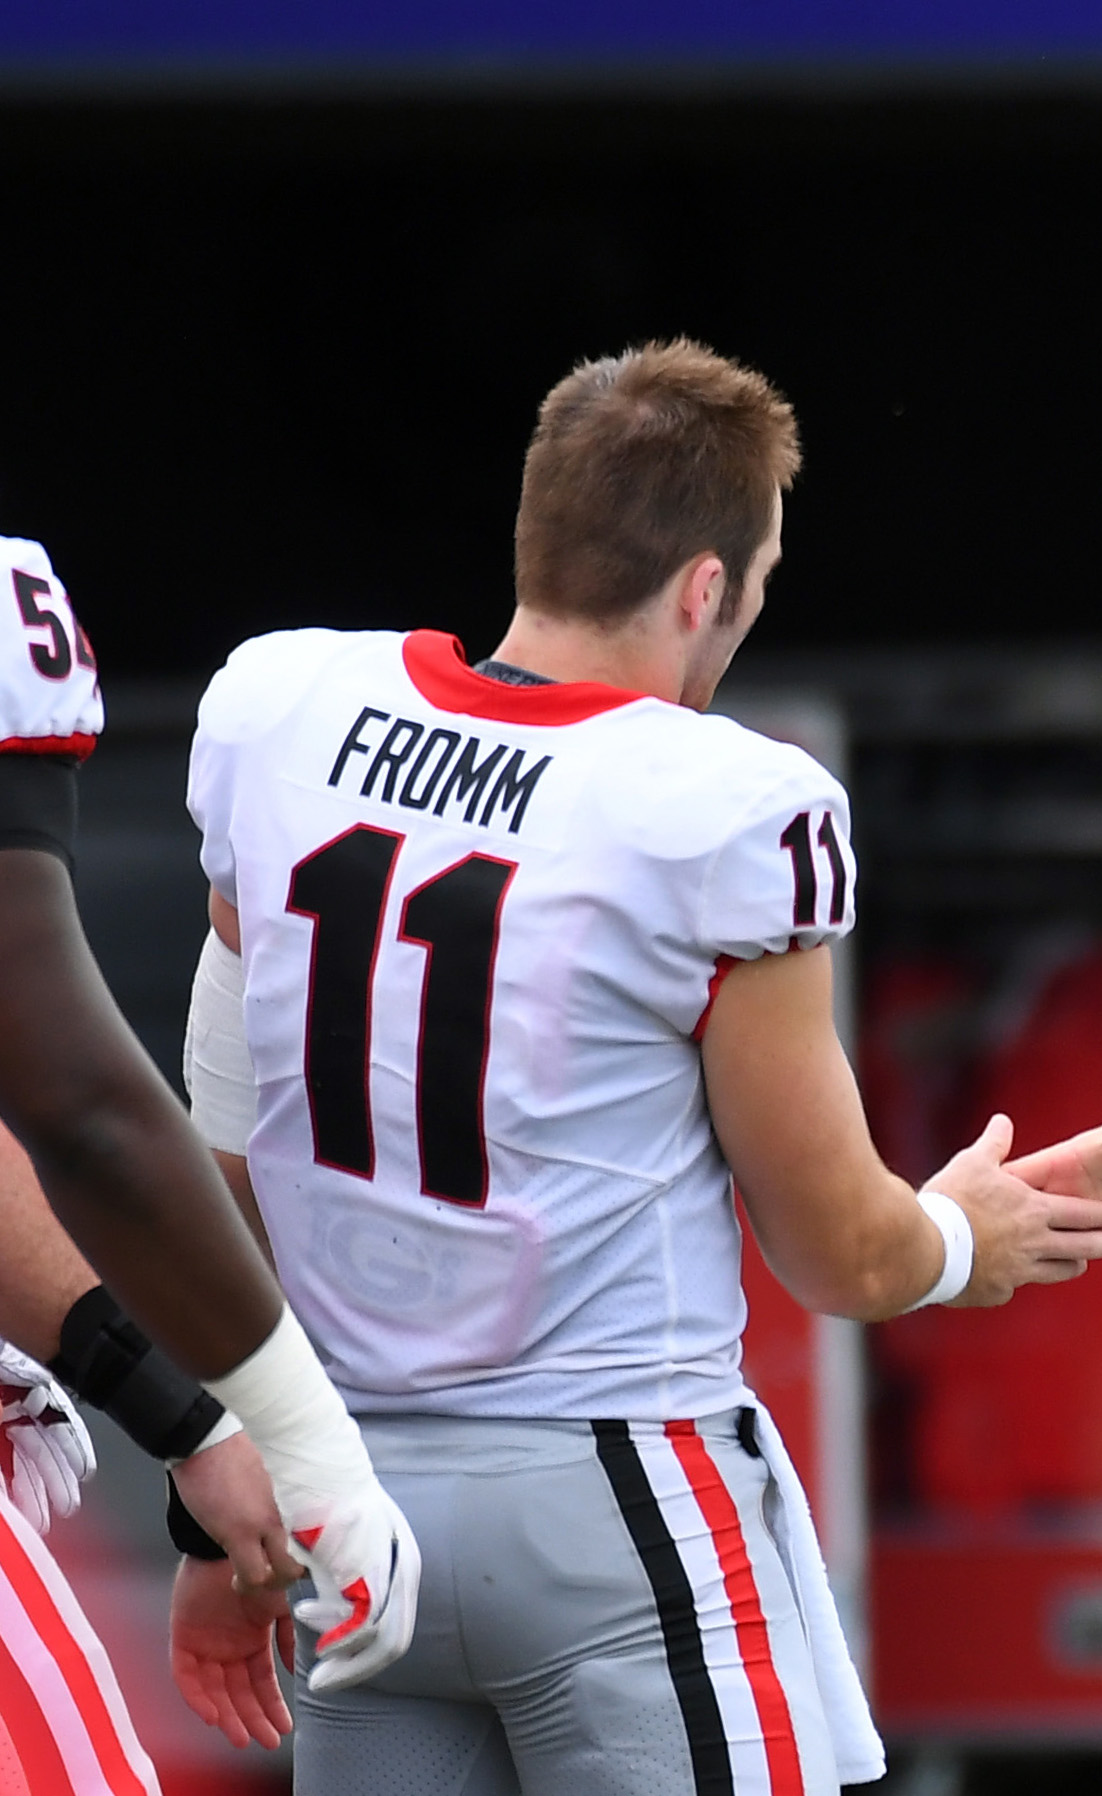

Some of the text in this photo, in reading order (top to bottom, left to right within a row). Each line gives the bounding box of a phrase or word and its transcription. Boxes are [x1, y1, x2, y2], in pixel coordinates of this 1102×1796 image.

[327, 706, 554, 835] FROMM
[780, 811, 847, 926] 11
[285, 822, 520, 1210] 11
